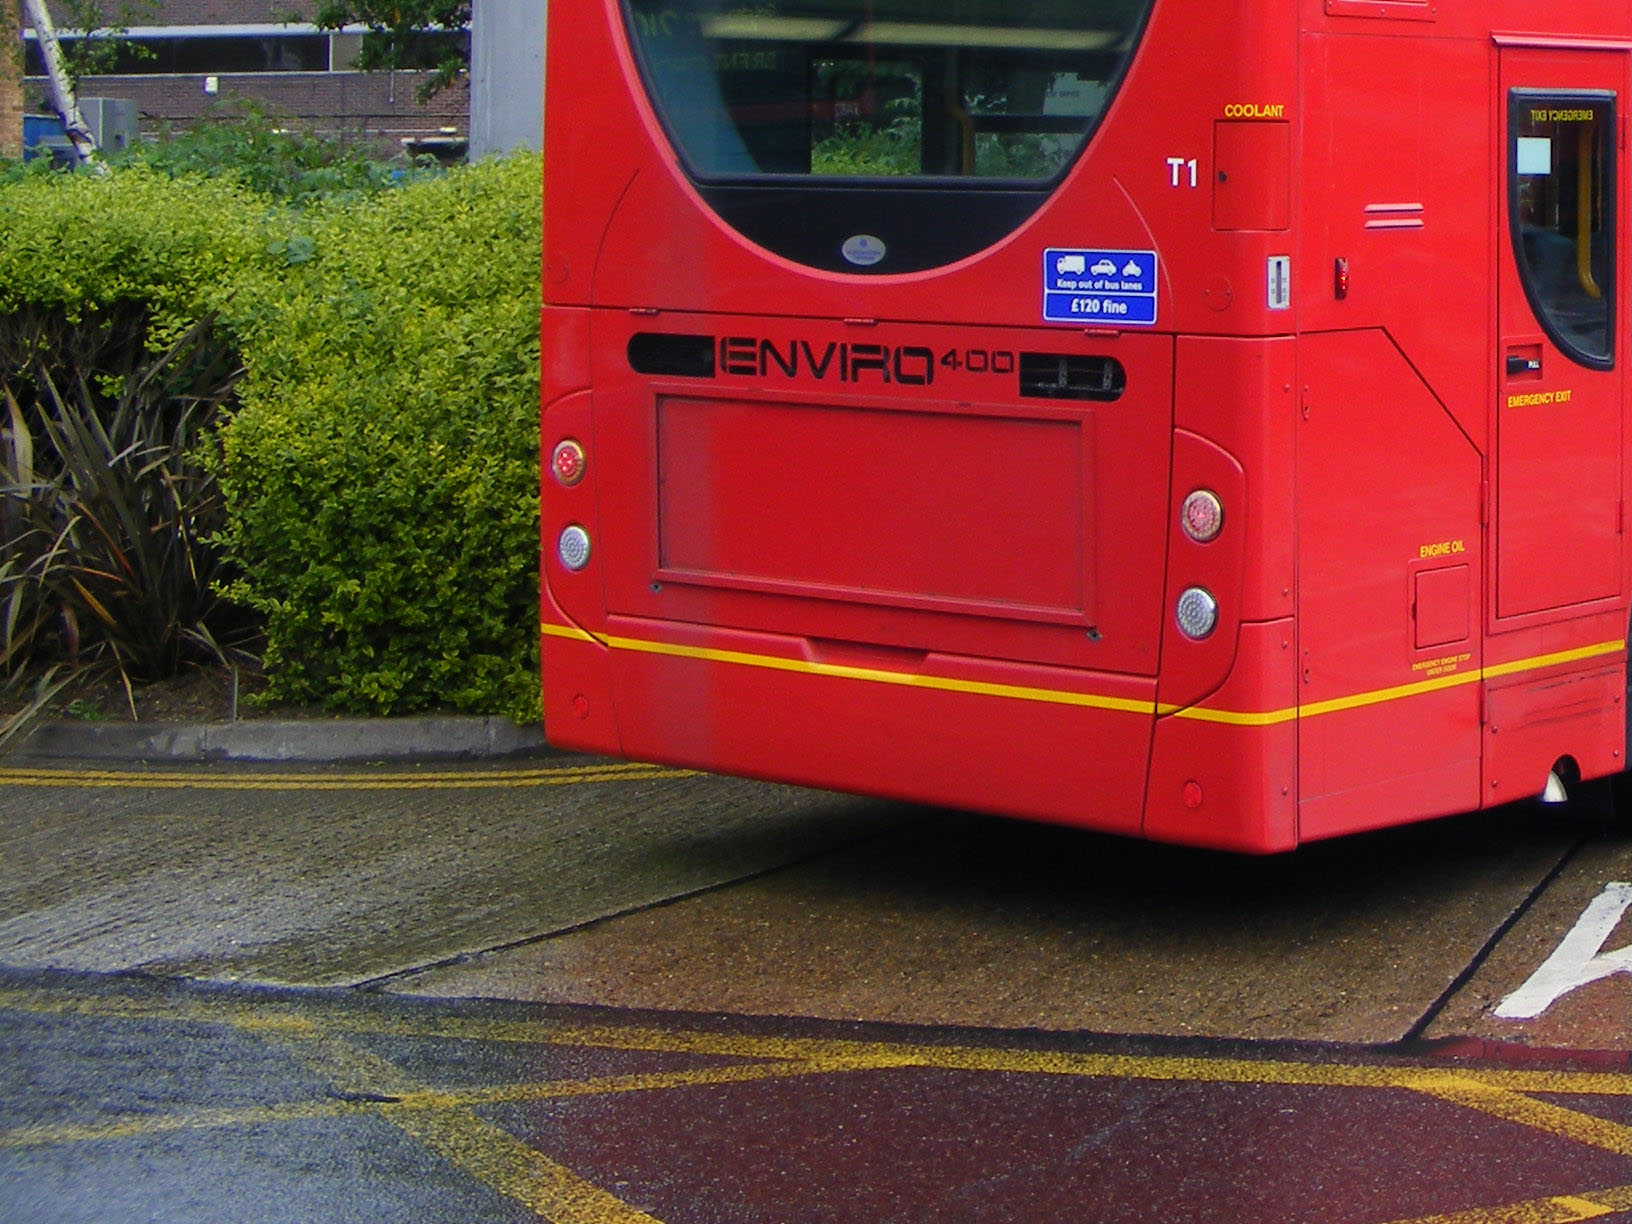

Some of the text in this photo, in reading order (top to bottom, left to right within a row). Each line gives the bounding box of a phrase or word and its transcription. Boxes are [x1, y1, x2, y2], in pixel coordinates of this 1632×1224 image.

[1224, 103, 1284, 118] COOLANT
[1167, 158, 1198, 187] T1
[1057, 278, 1143, 291] Keep out of bus lanes
[1071, 297, 1128, 315] £120 fine
[719, 336, 1015, 386] ENVIRO 400
[1508, 390, 1572, 408] EMERGENCY EXIT
[1420, 540, 1465, 558] ENGINE OIL
